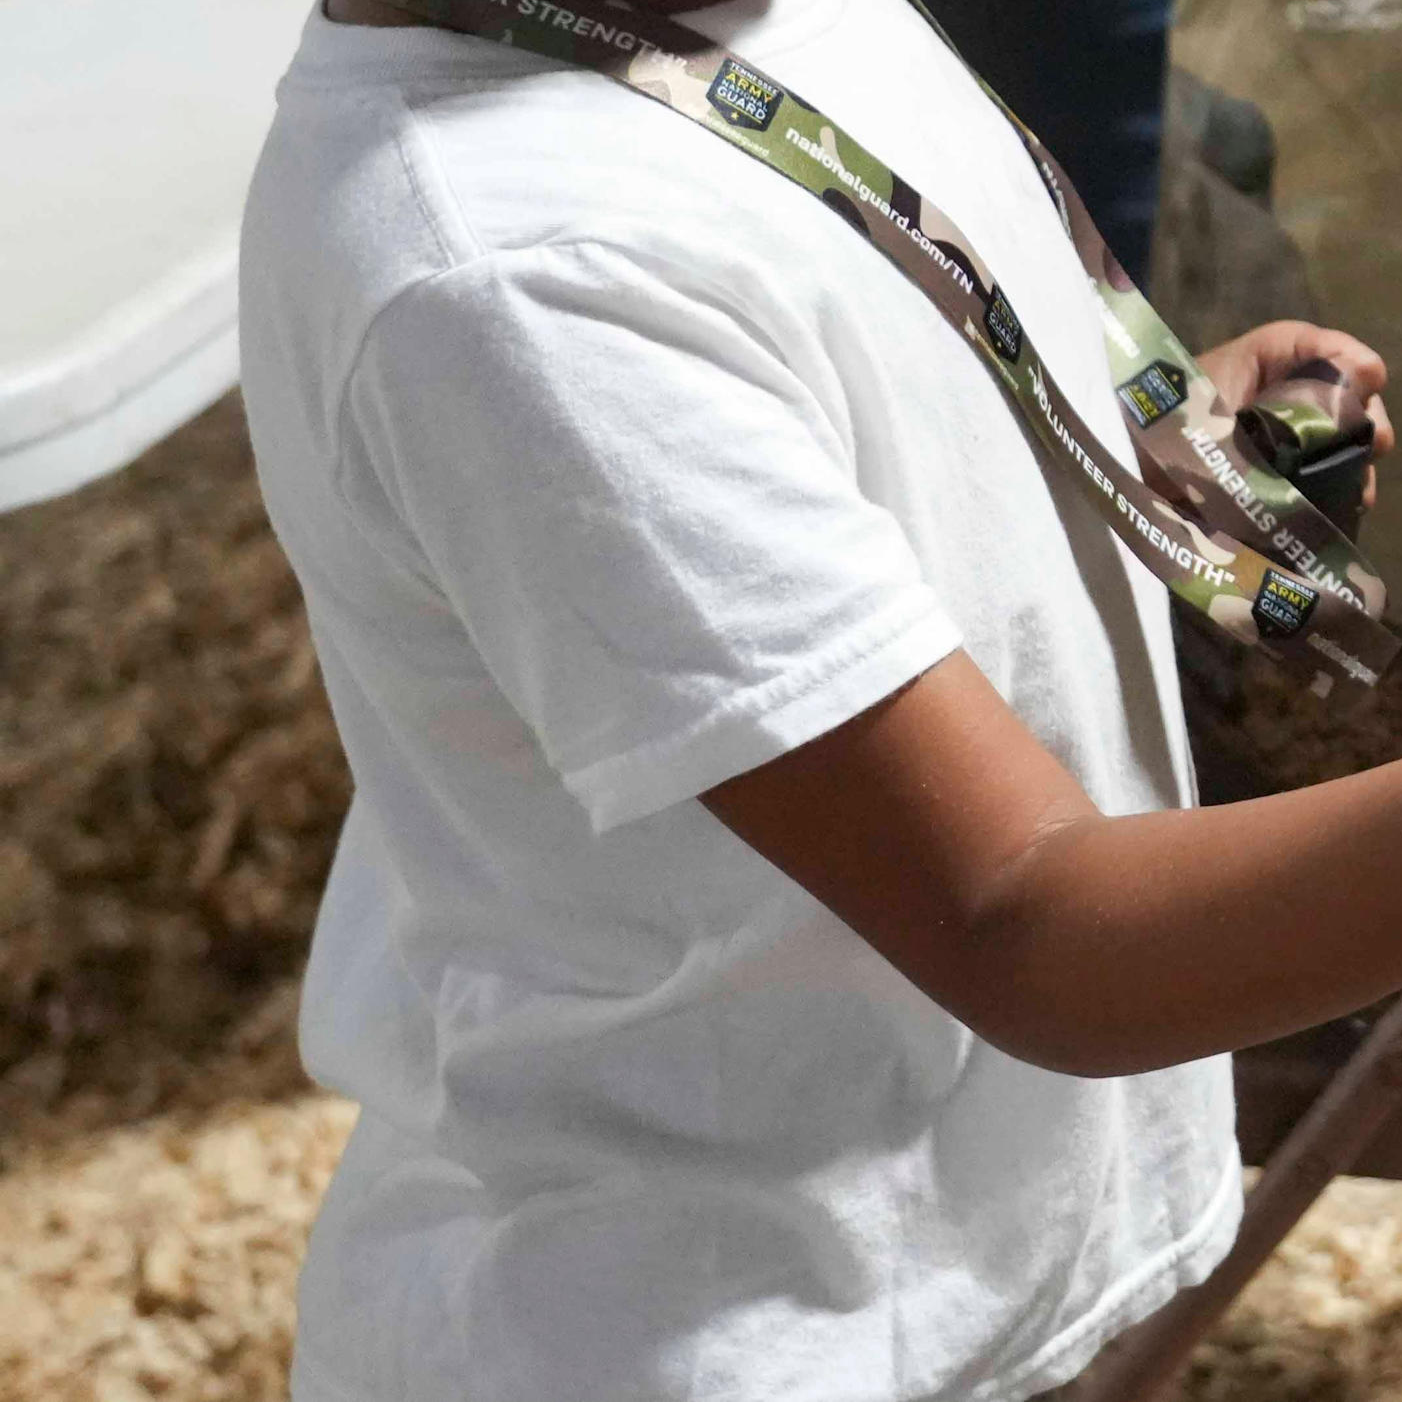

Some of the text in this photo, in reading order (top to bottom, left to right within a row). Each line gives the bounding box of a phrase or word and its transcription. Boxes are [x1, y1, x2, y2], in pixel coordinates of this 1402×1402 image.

[721, 79, 768, 112] NATIONAL
[726, 73, 773, 103] ARMY
[731, 62, 779, 96] TENNESSEE
[717, 86, 766, 120] GUARD
[785, 124, 974, 295] nationalguard.com/TN
[1267, 581, 1309, 611] ARMY
